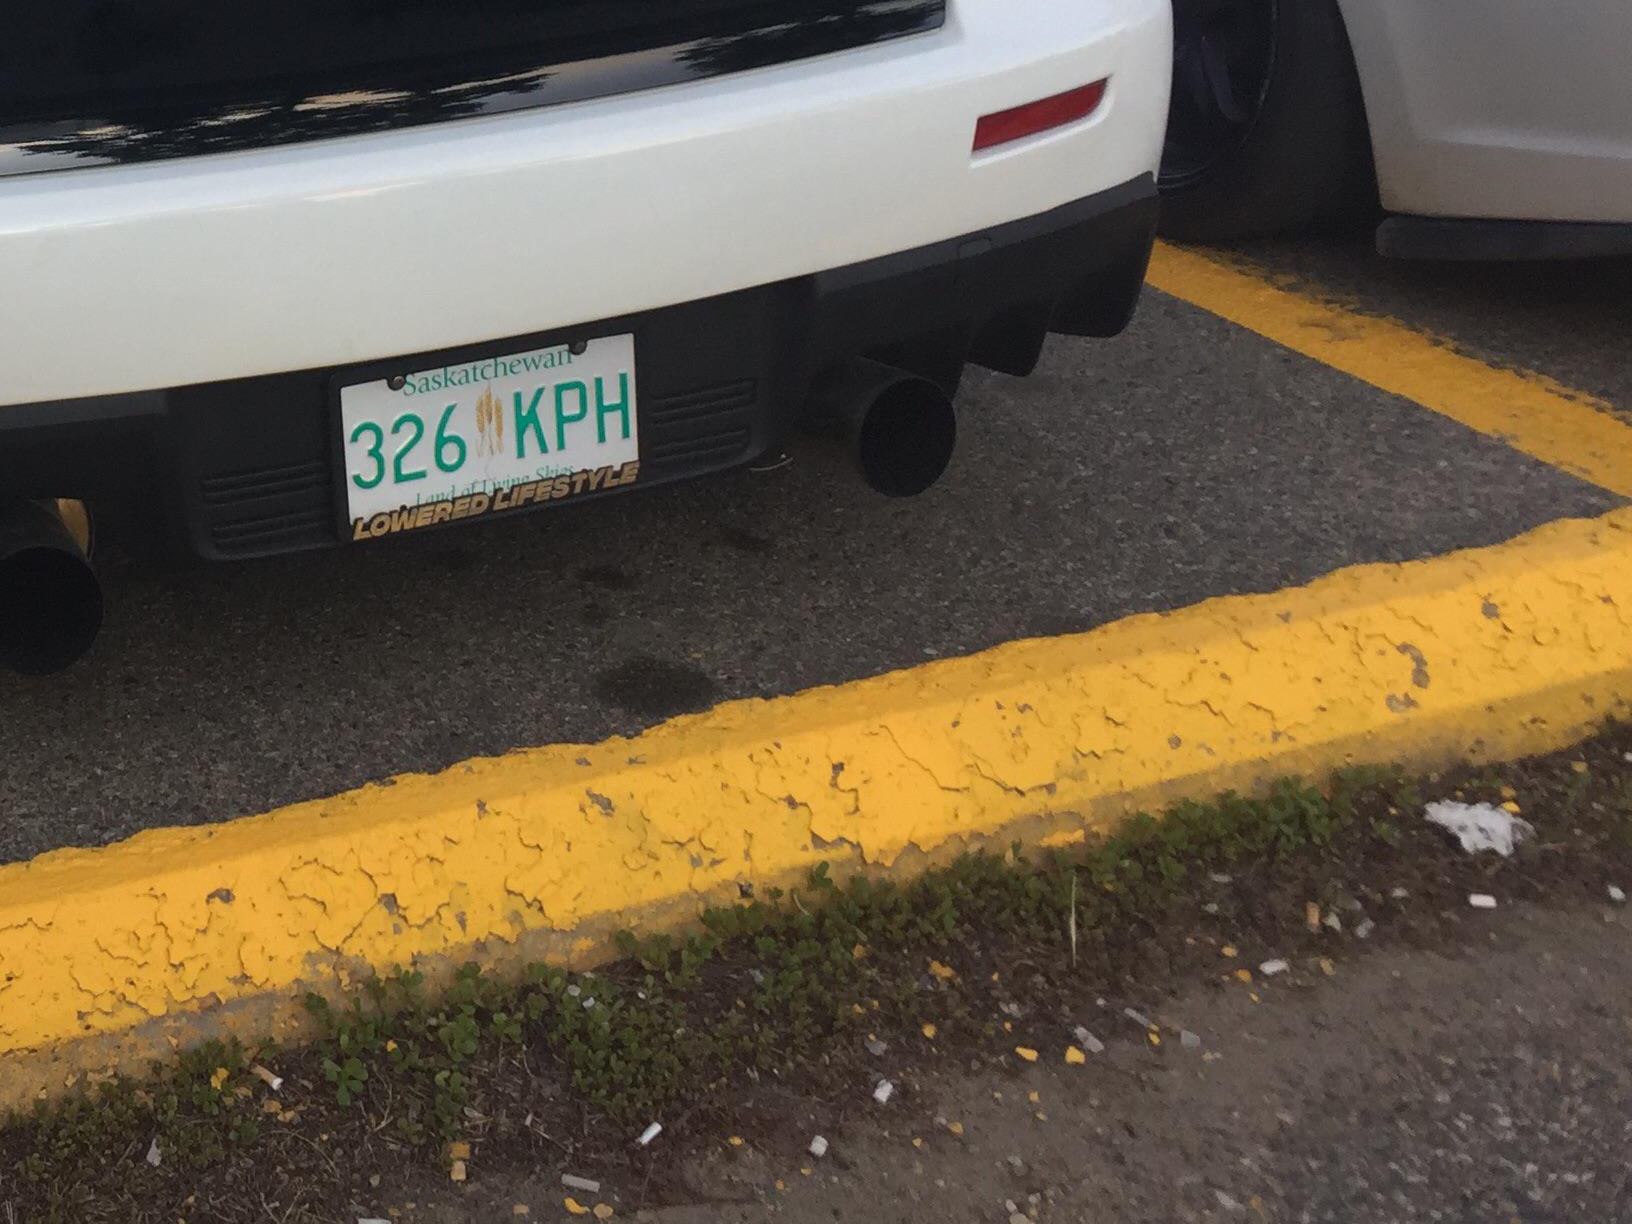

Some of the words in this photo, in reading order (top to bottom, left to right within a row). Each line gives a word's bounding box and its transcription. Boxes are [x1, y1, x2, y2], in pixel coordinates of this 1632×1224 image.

[402, 347, 575, 398] Saskatchewan
[350, 402, 467, 489] 326
[512, 373, 631, 459] KPH
[352, 493, 491, 541] LOWERED
[492, 460, 641, 511] LIFESTYLE
